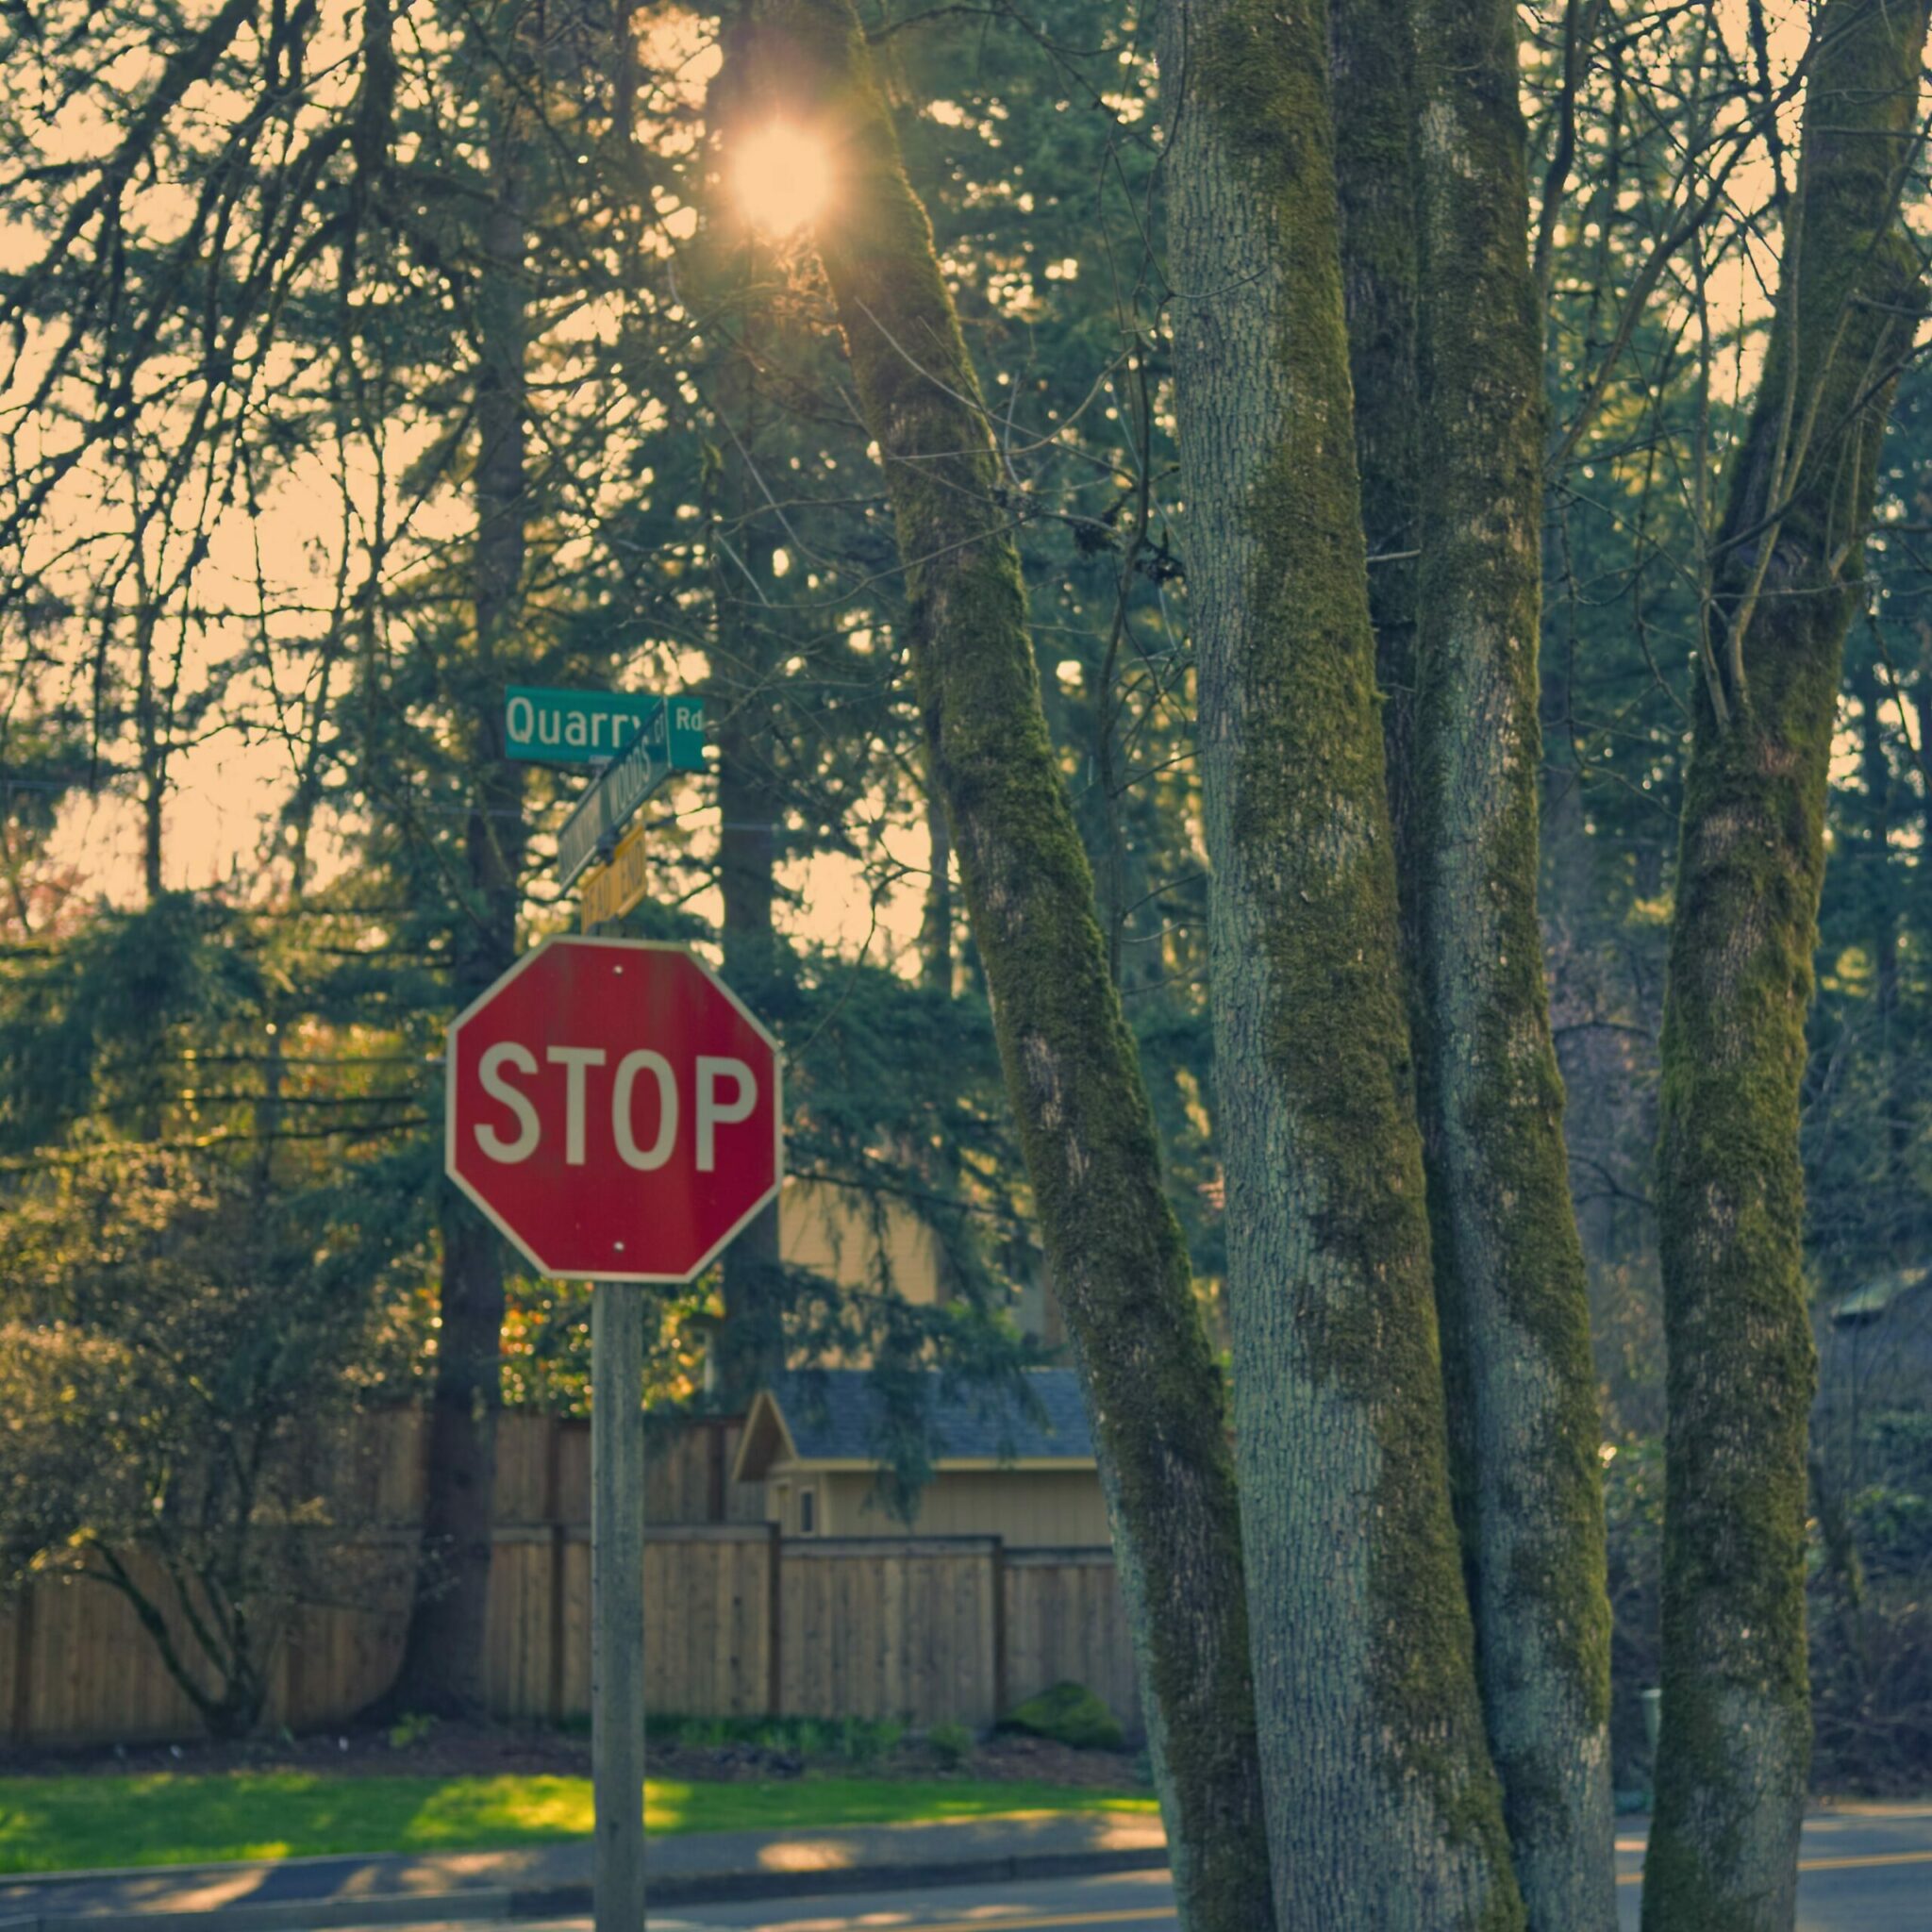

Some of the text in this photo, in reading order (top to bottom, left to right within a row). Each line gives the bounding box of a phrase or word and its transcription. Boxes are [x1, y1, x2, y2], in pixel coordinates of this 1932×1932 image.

[506, 696, 703, 748] Quarr Rd
[474, 1041, 758, 1172] STOP
